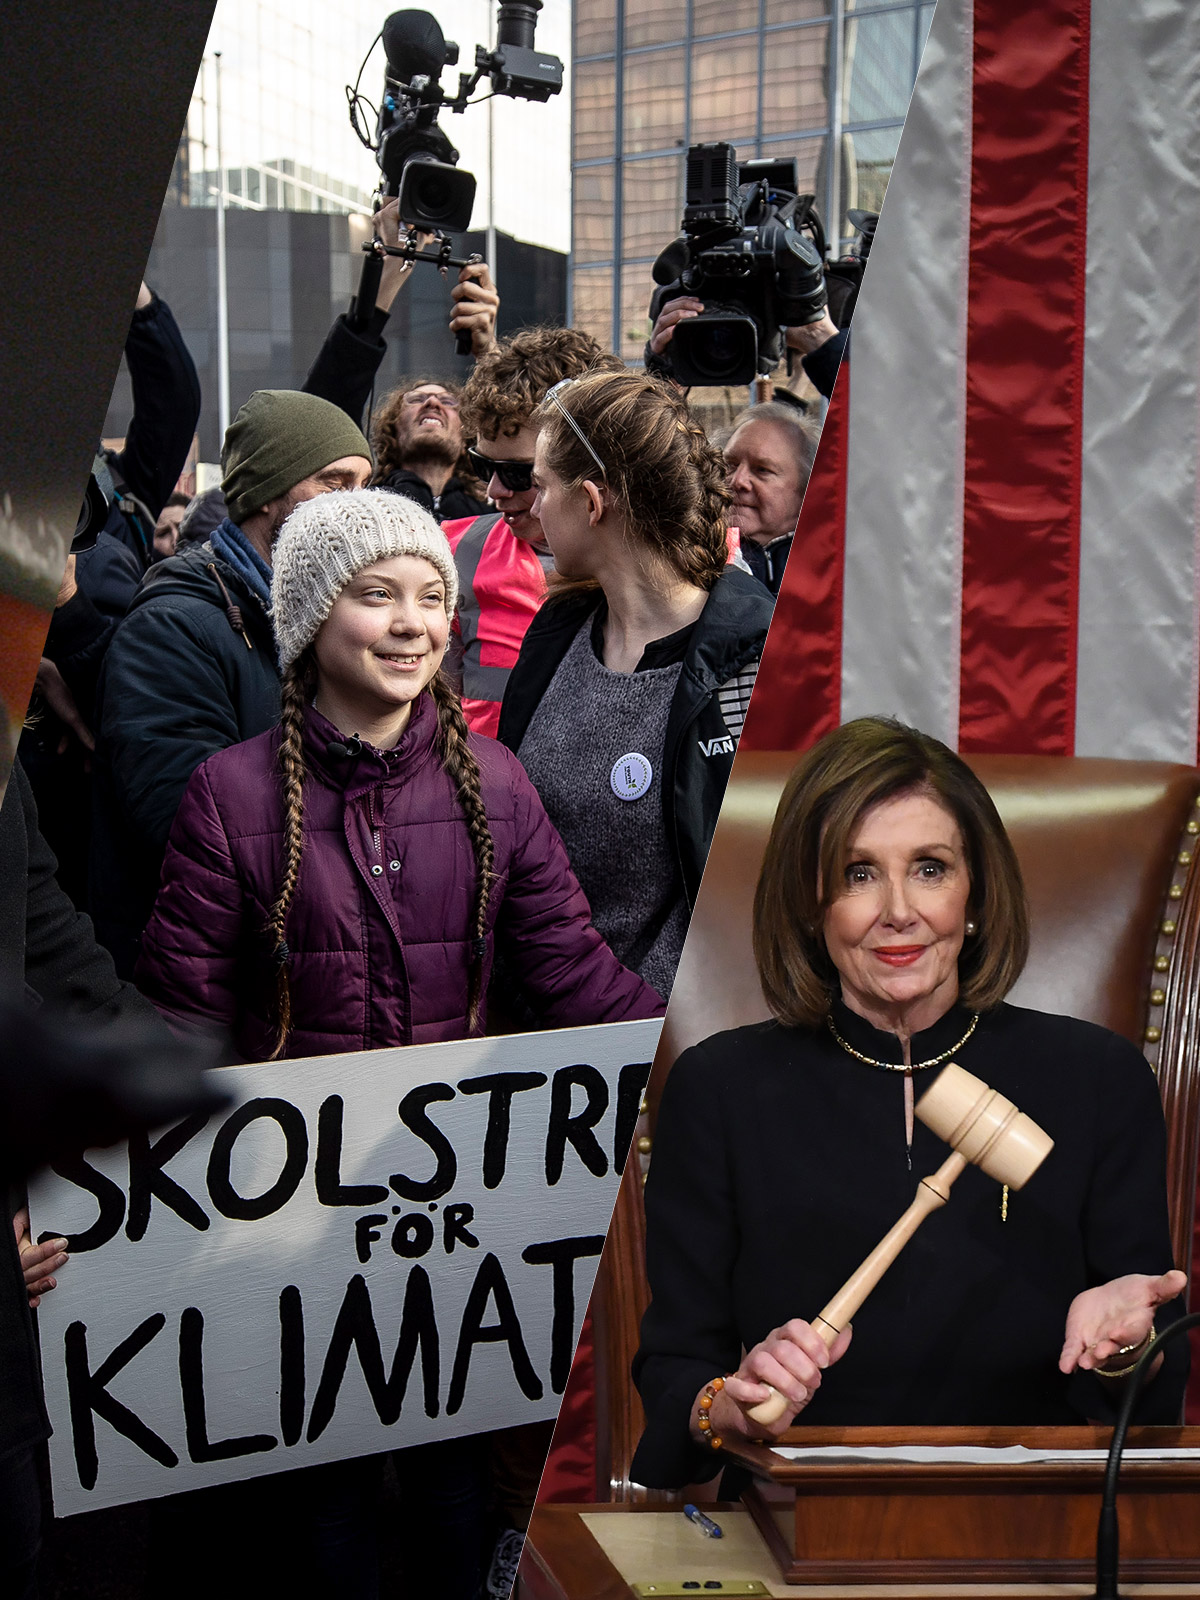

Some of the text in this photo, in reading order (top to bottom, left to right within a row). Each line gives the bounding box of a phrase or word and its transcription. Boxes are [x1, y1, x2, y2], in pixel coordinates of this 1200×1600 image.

[698, 735, 735, 757] VAN
[355, 1202, 480, 1263] FÖR
[65, 1235, 606, 1490] KLIMAT
